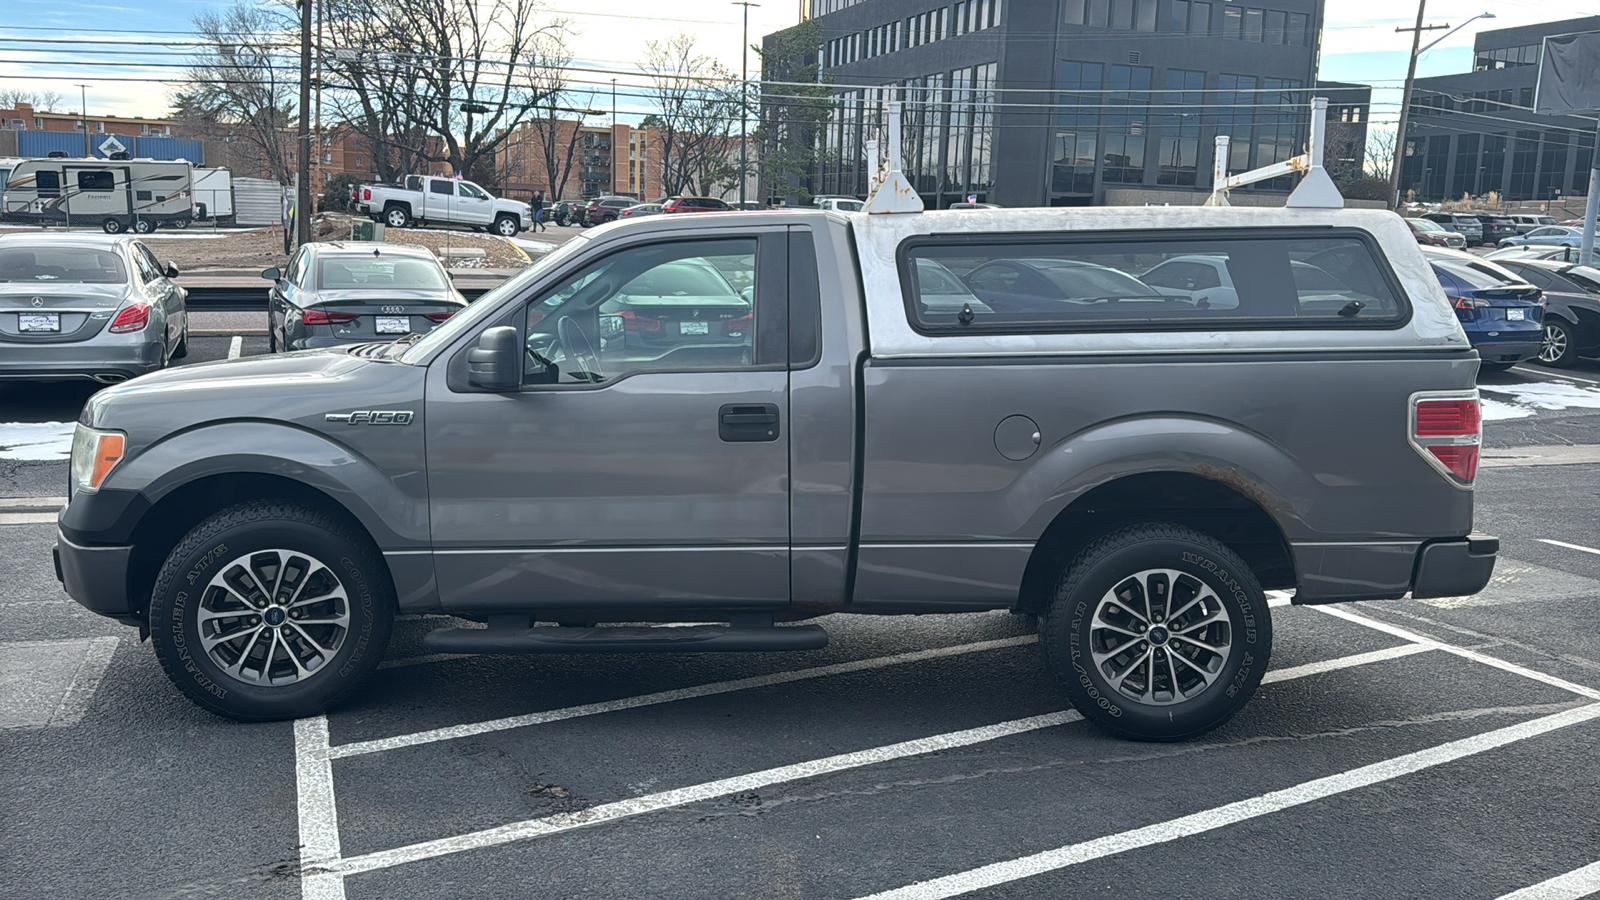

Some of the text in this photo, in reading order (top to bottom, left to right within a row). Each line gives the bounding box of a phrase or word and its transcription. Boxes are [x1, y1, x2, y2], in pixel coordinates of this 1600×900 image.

[173, 544, 228, 699] WRANGLER AT/S
[340, 557, 374, 678] GOODYEAR
[1069, 601, 1122, 718] GOODYEAR
[1182, 551, 1257, 698] WRANGLER AT/S
